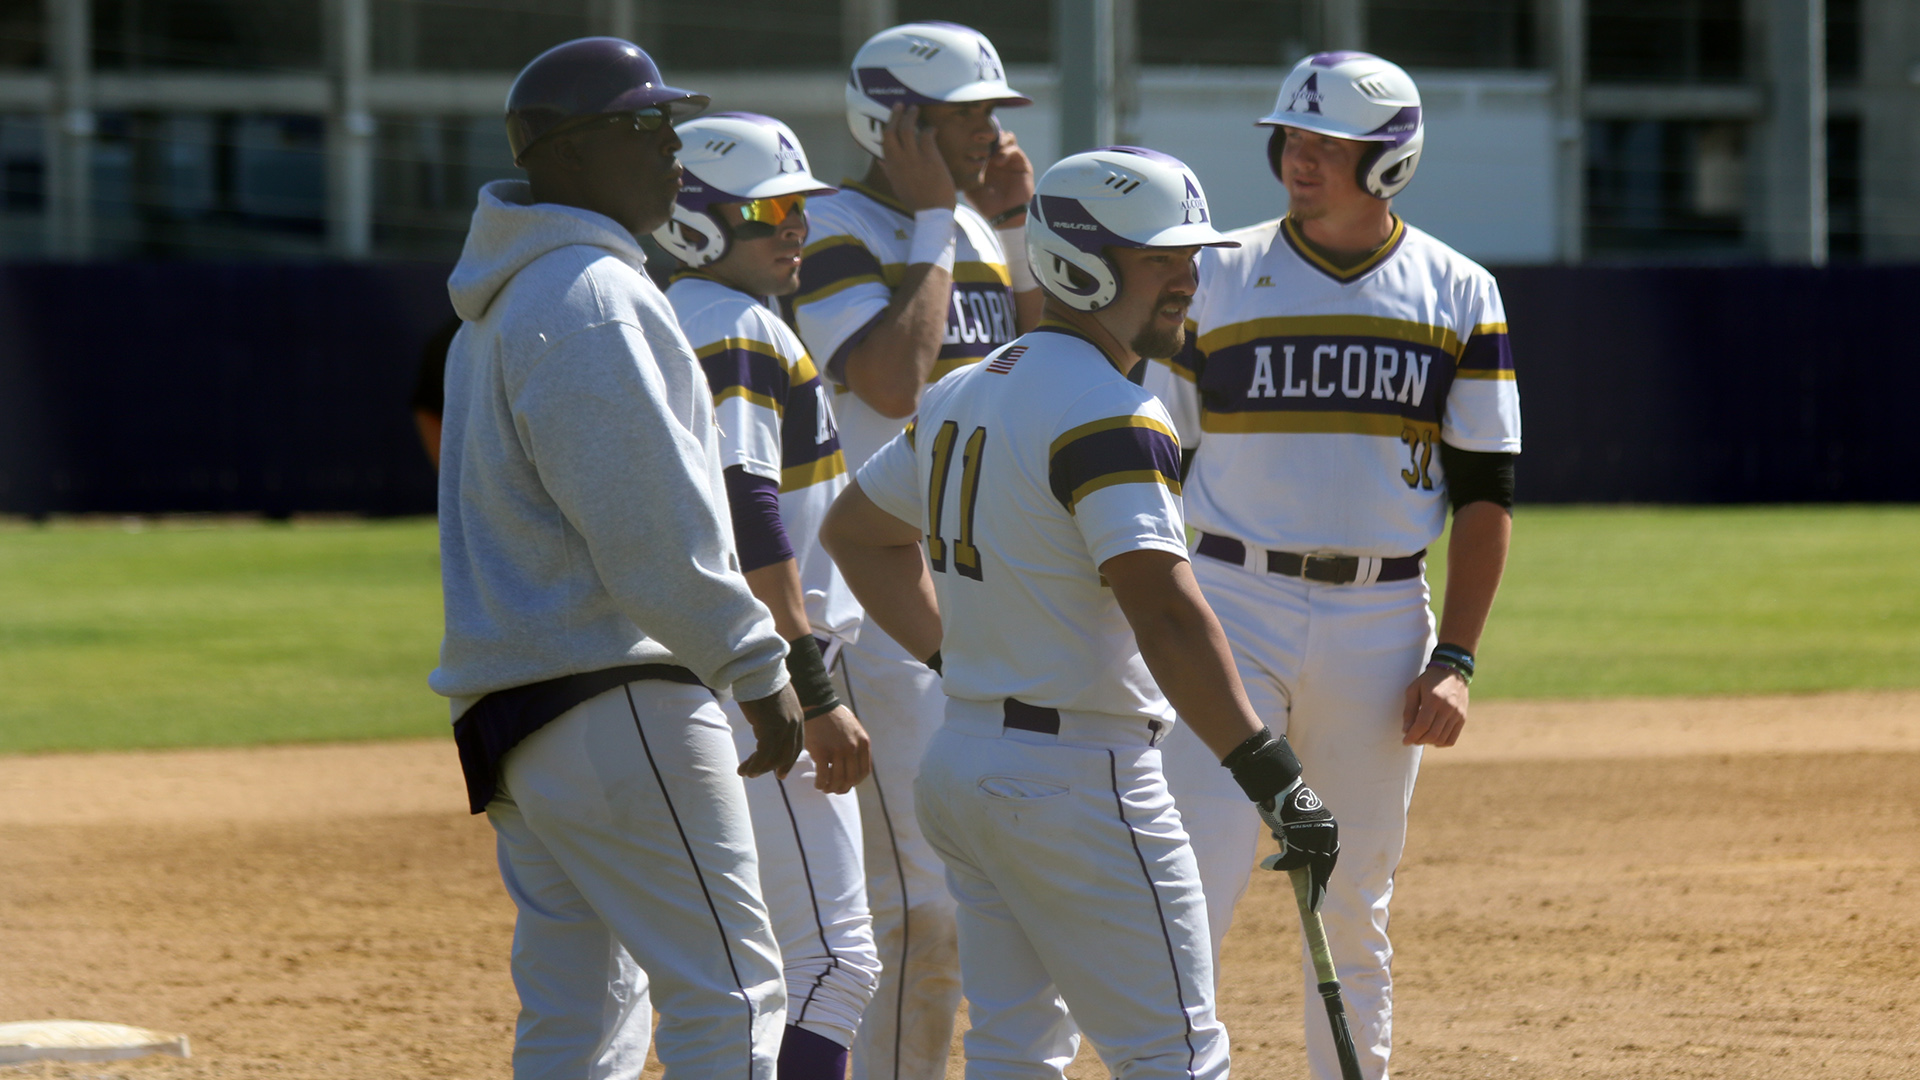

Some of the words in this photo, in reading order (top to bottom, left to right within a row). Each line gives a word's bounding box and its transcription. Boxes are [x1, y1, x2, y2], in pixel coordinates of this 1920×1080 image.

[1181, 173, 1209, 226] A
[943, 289, 1017, 344] LCORN
[1247, 344, 1432, 408] ALCORN
[926, 420, 987, 582] 11
